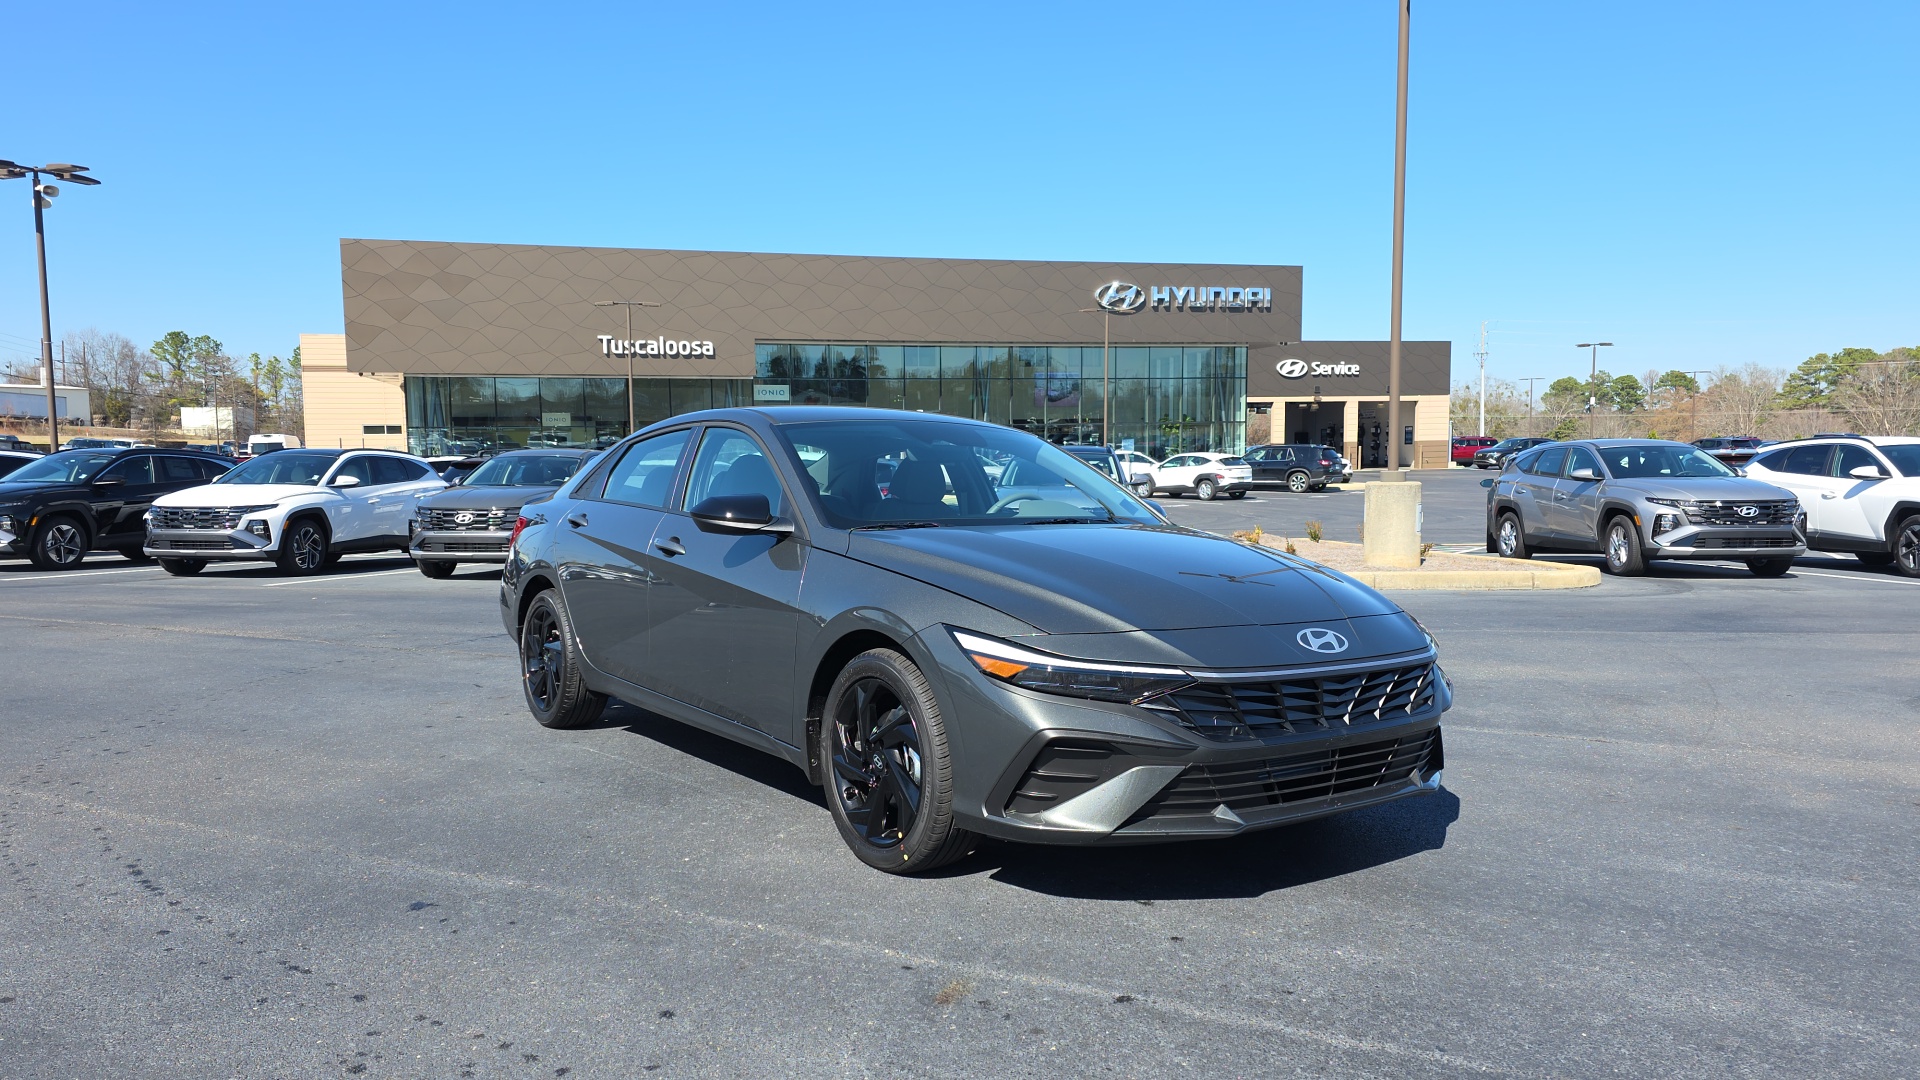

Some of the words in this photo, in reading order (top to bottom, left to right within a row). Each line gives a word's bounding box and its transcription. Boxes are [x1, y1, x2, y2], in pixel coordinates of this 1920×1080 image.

[1151, 286, 1272, 308] HYUNDAI
[597, 335, 715, 356] Tuscaloosa
[1311, 361, 1360, 375] Service
